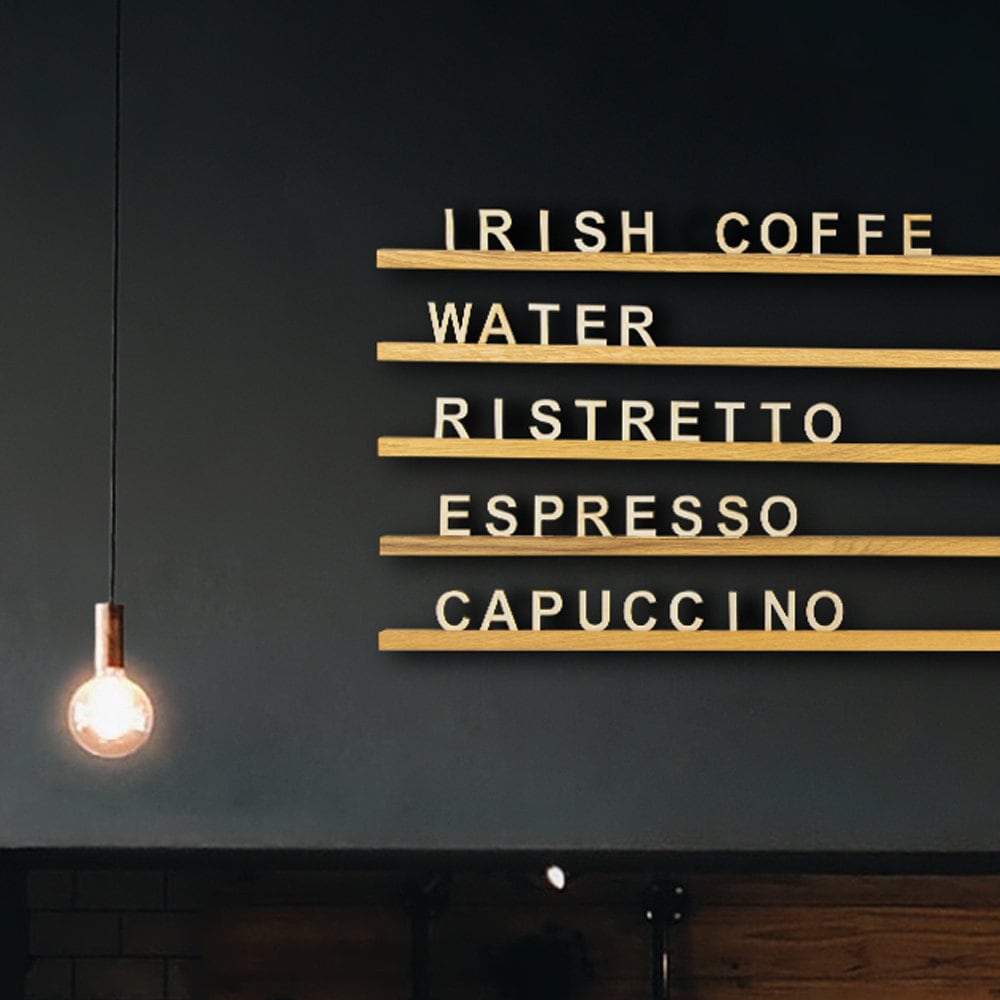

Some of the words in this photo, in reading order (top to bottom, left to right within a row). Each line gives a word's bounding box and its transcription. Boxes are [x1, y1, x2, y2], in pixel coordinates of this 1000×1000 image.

[444, 208, 654, 253] IRISH
[715, 212, 932, 256] COFFE
[427, 301, 656, 346] WATER
[434, 397, 842, 443] RISTRETTO
[439, 494, 798, 538] ESPRESSO
[435, 590, 844, 632] CAPUCCINO
